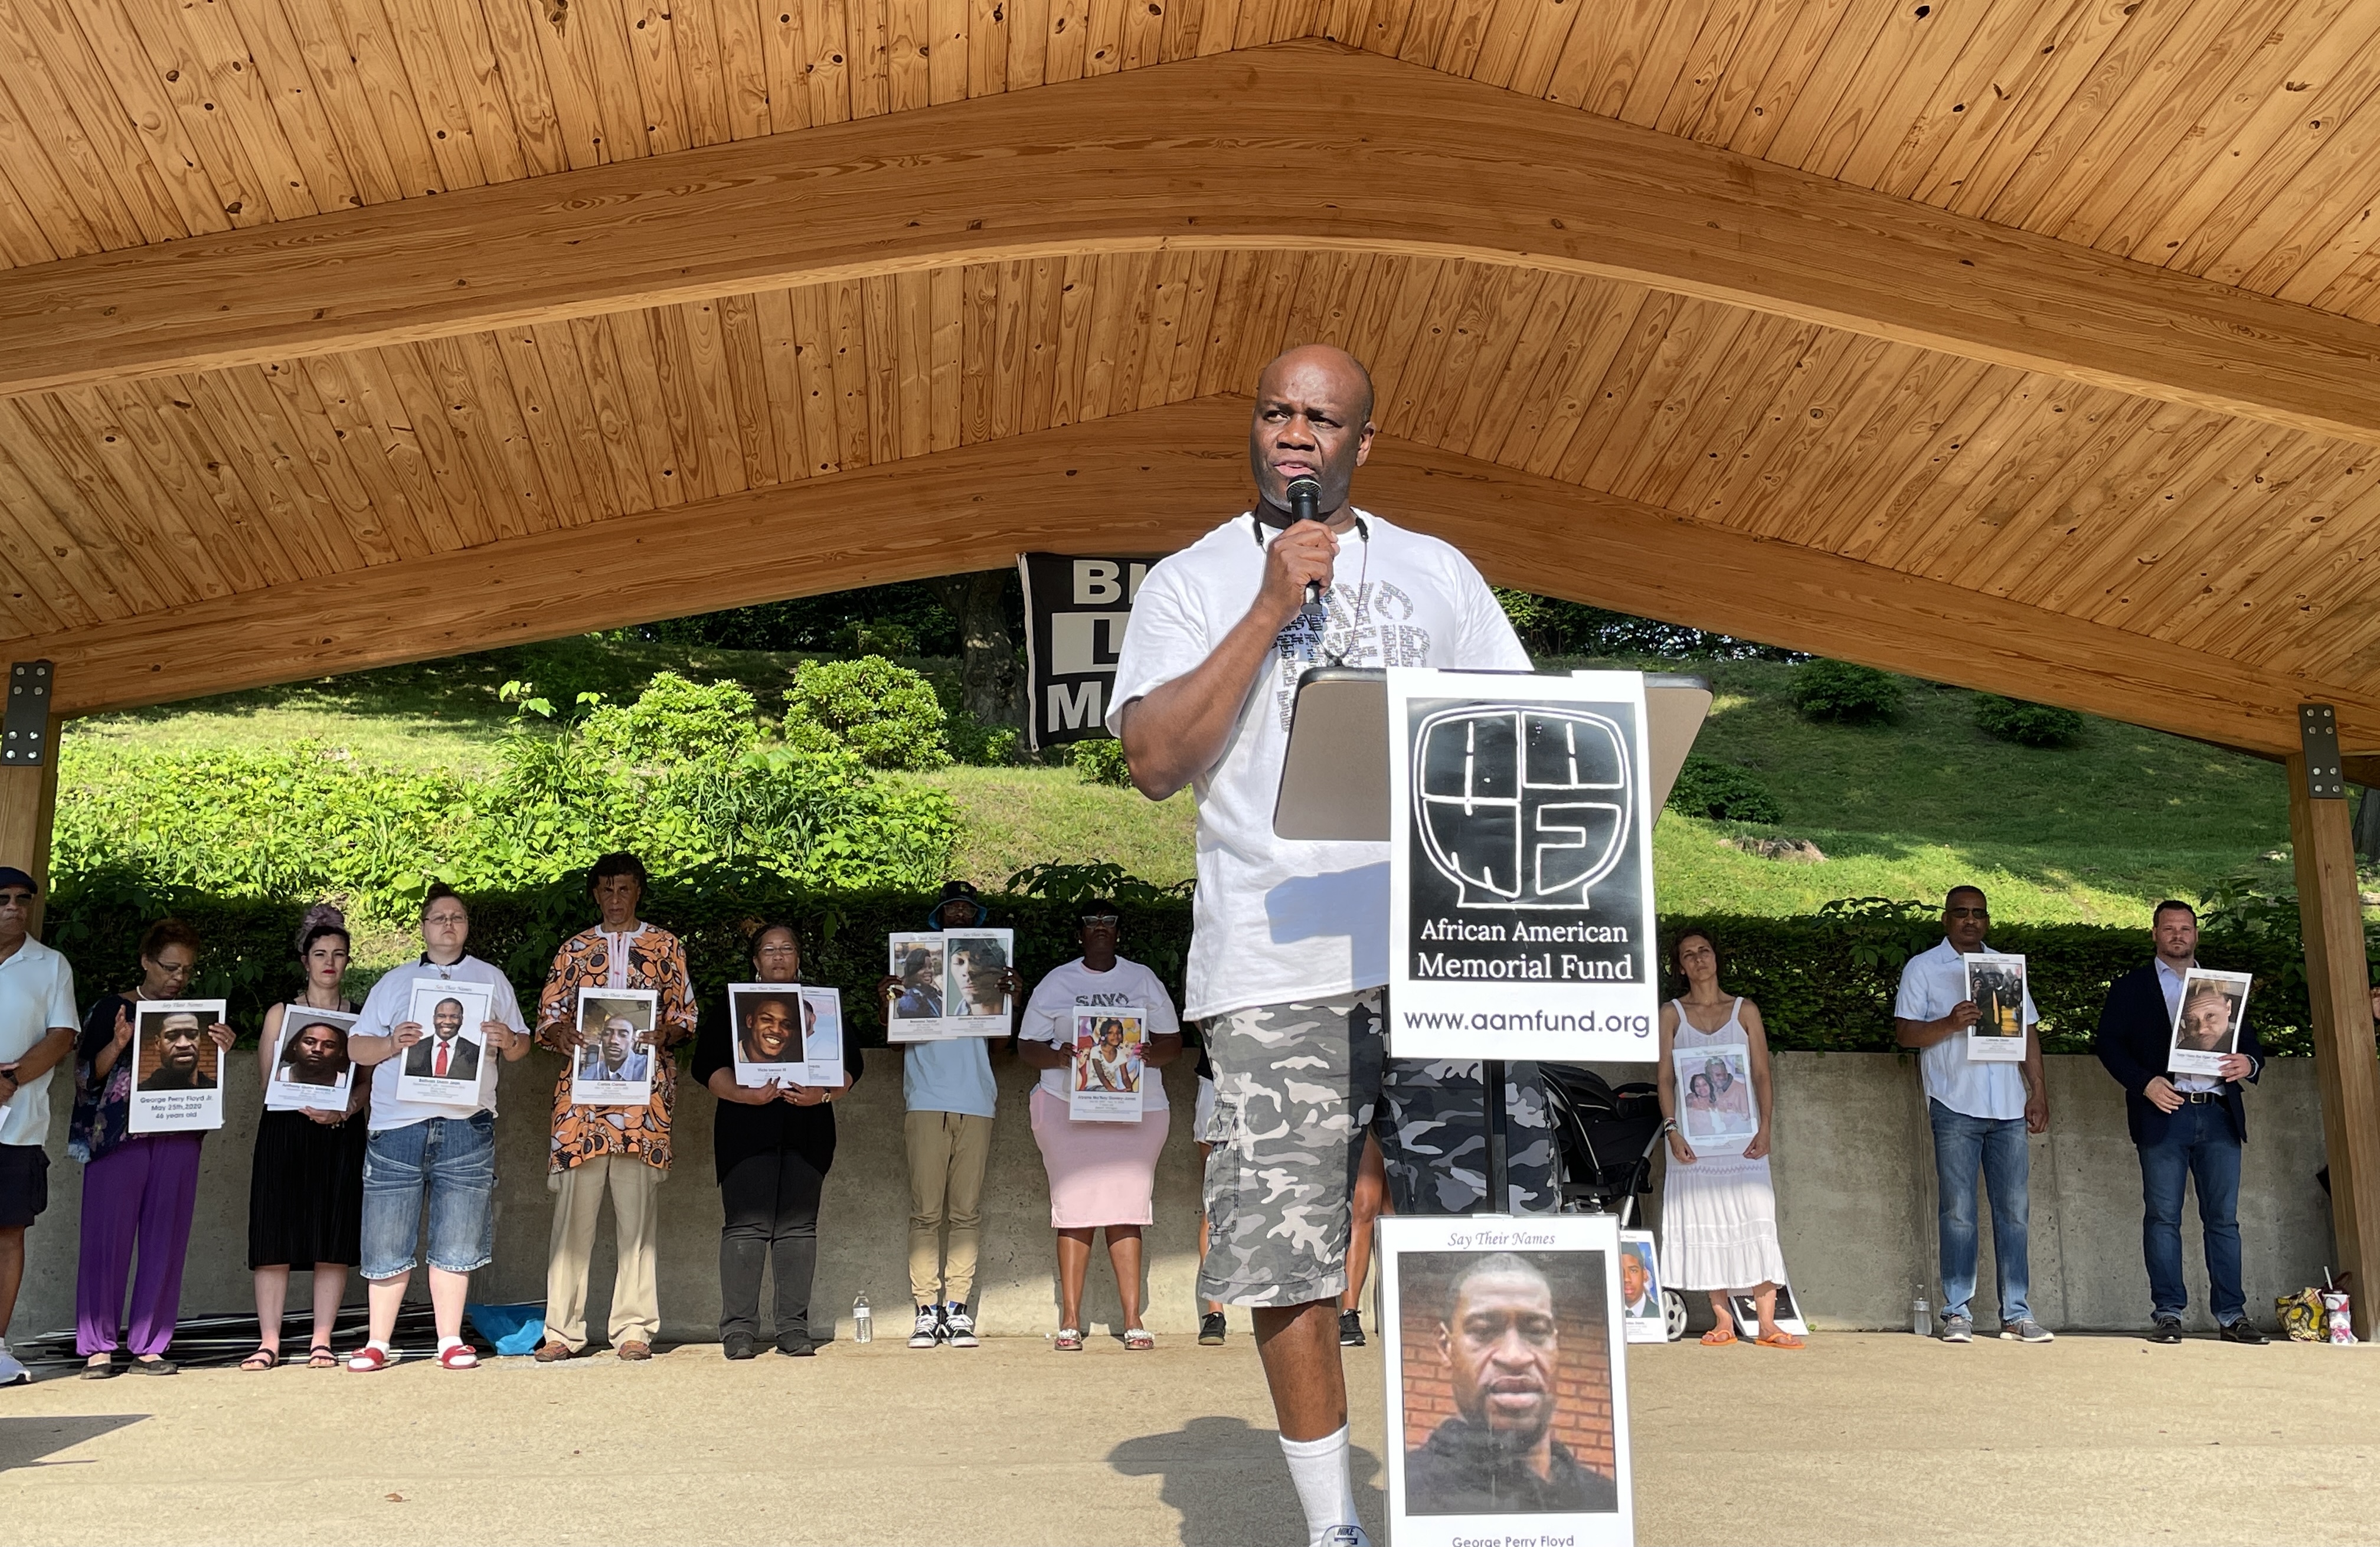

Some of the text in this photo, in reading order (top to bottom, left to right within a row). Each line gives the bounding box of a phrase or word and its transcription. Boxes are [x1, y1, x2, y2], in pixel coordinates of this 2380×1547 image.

[1420, 918, 1629, 943] African American
[1417, 951, 1634, 980] Memorial Fund
[1403, 1009, 1650, 1039] www.aamfund.org
[1447, 1231, 1556, 1250] Say Their Names
[1336, 1527, 1355, 1536] NIKE
[1451, 1535, 1574, 1547] George Perry Floyd
